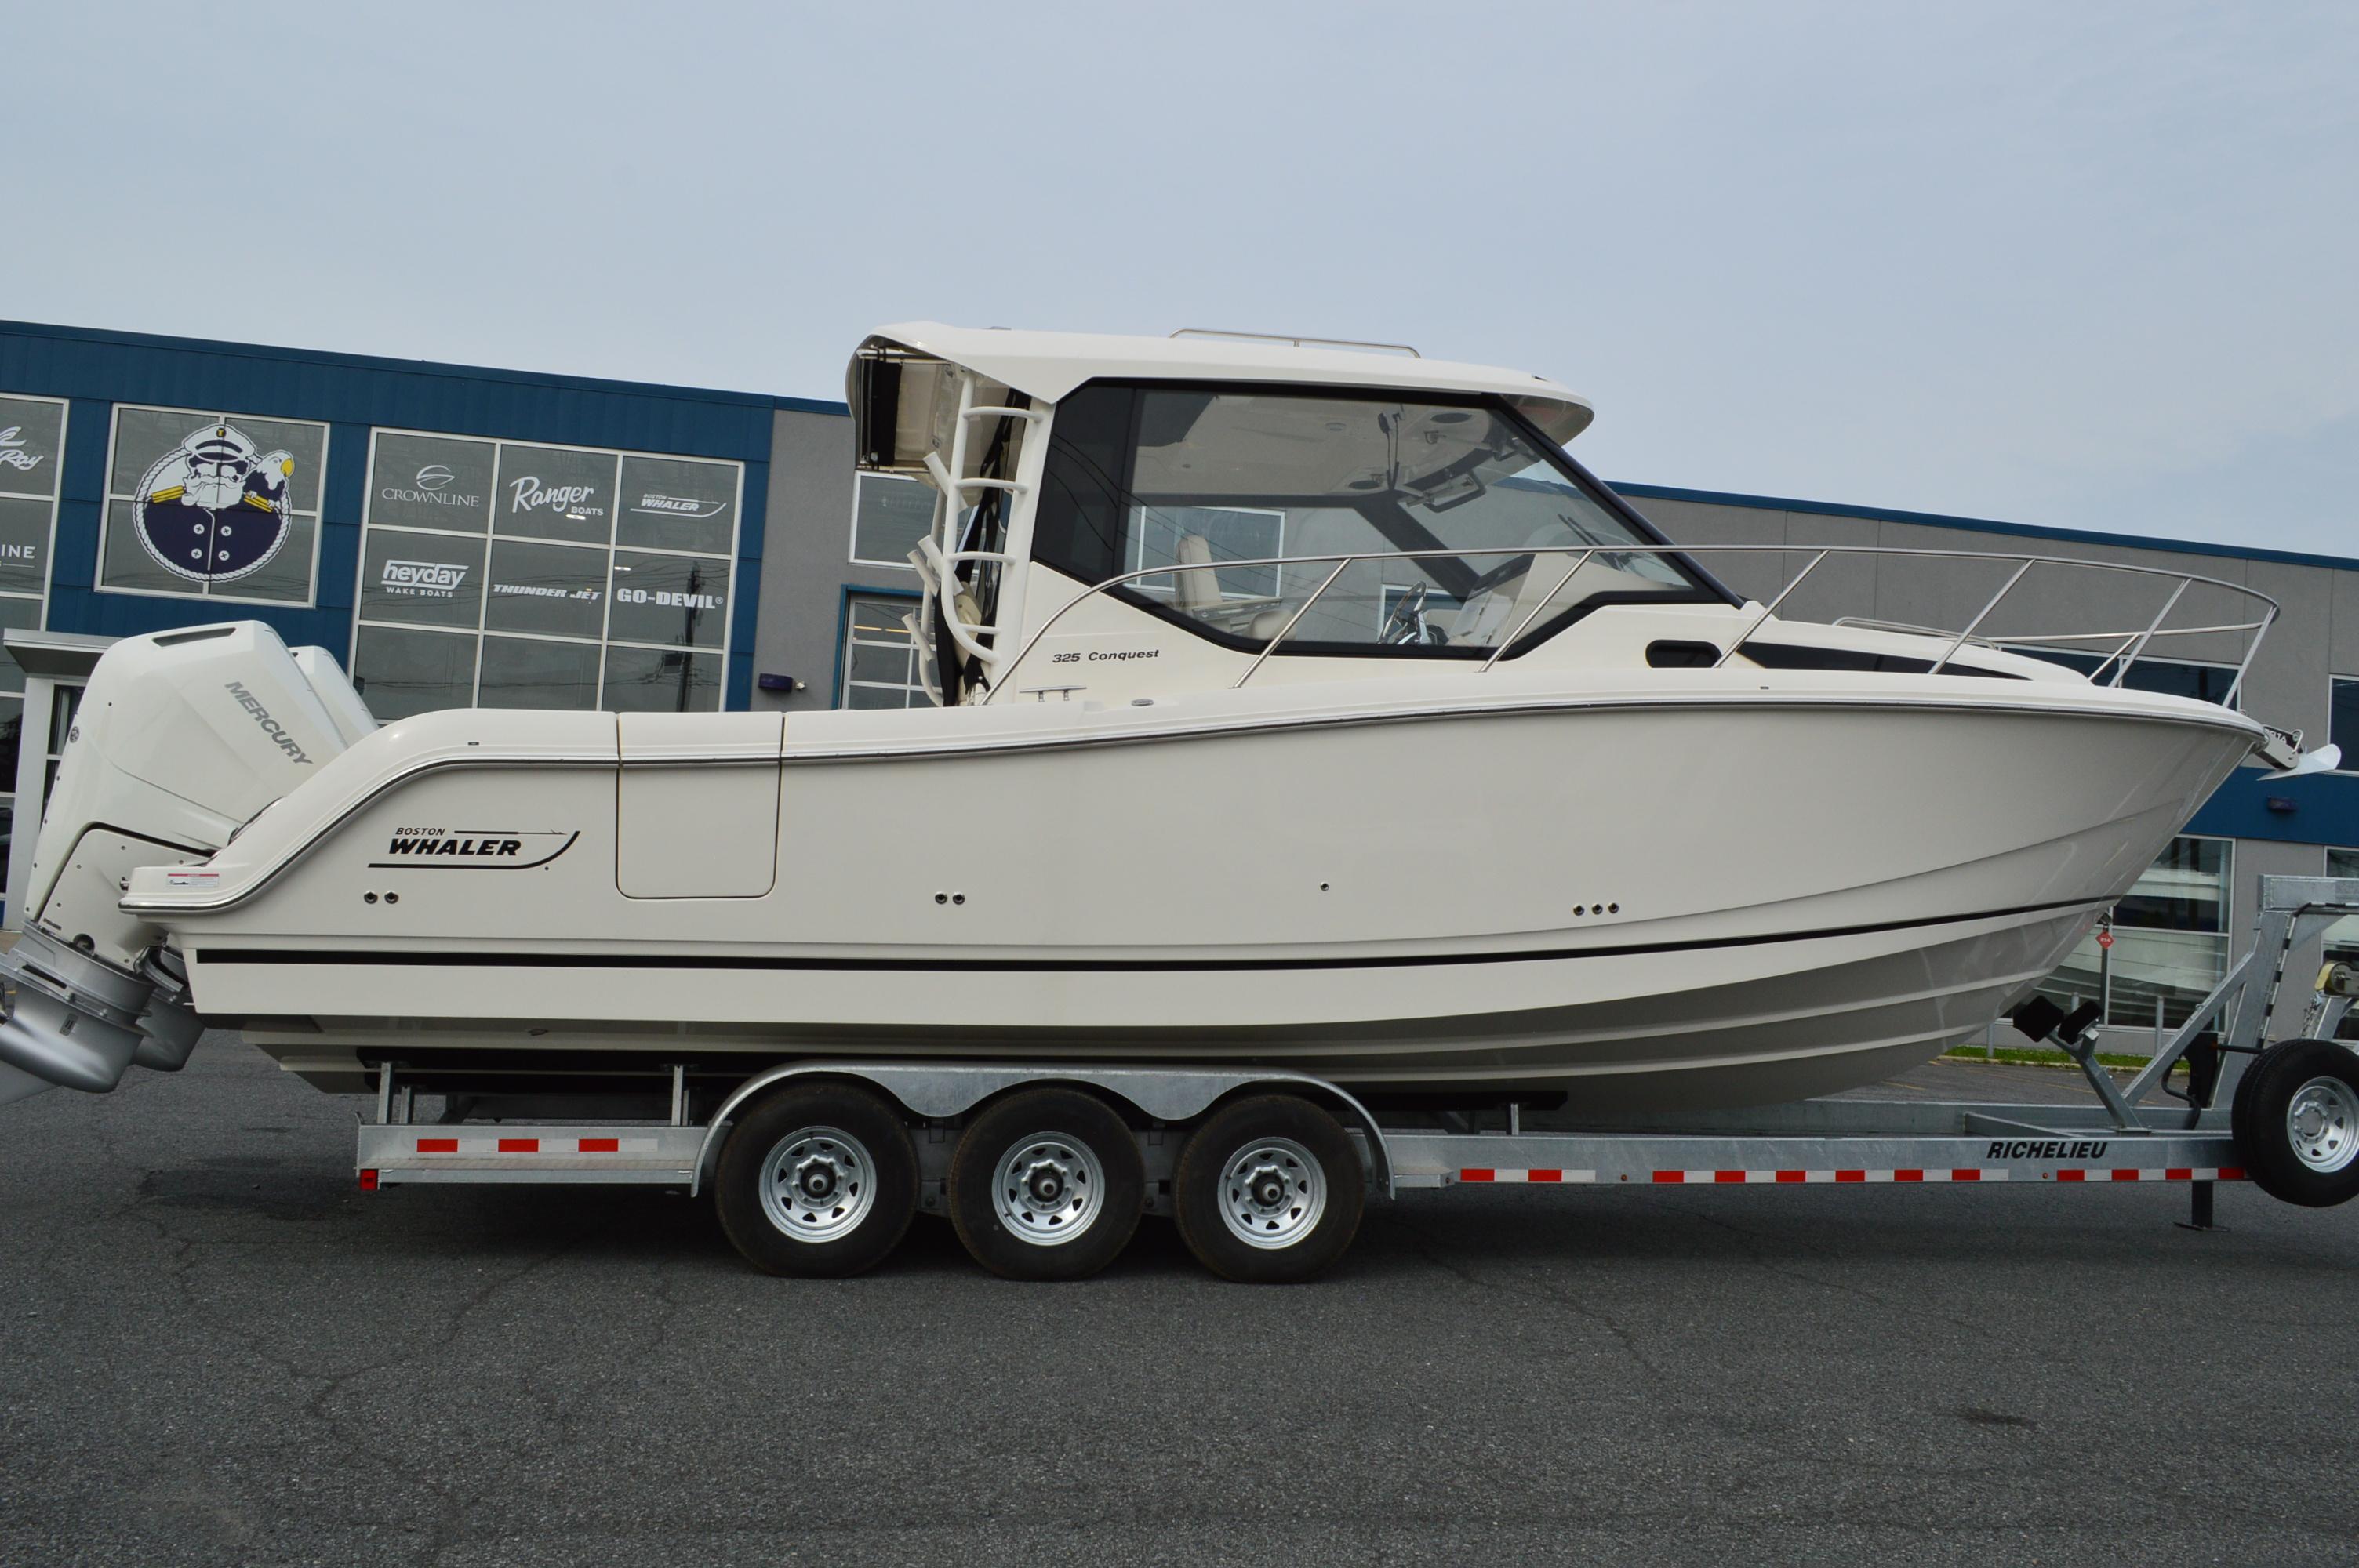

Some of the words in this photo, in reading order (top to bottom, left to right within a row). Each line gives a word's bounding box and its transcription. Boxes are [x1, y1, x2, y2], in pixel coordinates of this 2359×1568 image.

[382, 488, 479, 507] CROWNLINE
[509, 476, 594, 514] Ranger
[571, 506, 604, 516] BOATS
[641, 498, 700, 512] WHALER
[382, 559, 469, 590] heyday
[386, 586, 416, 595] WAKE
[420, 589, 453, 598] BOATS
[493, 583, 567, 598] THUNDER
[569, 590, 602, 601] JET
[1052, 652, 1081, 663] 325
[1088, 649, 1160, 662] Conquest
[224, 681, 314, 765] MERCURY
[395, 827, 445, 836] BOSTON
[389, 838, 522, 855] WHALER
[1986, 1142, 2108, 1159] RICHELIEU
